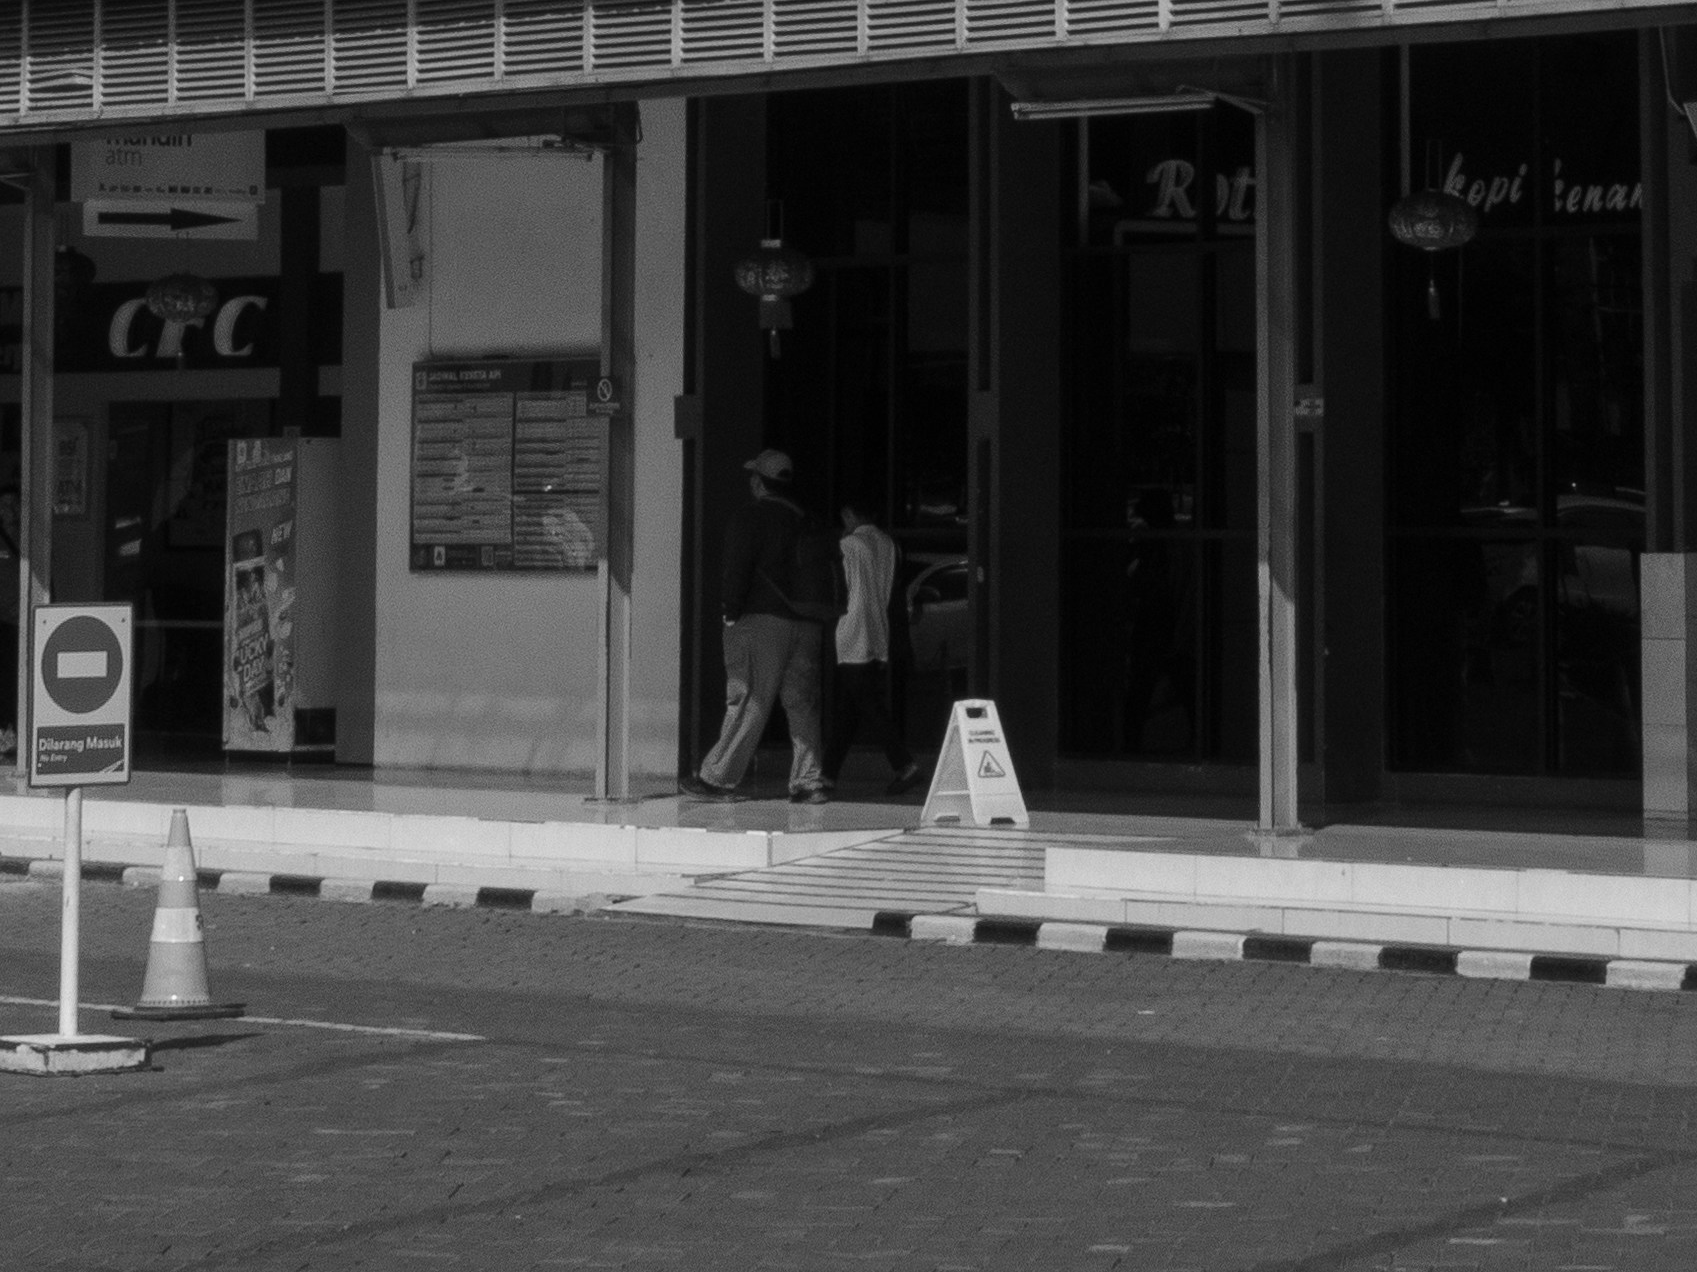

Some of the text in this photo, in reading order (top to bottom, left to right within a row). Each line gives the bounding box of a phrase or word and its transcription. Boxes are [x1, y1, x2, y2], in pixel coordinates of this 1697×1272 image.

[106, 149, 142, 166] atm
[1443, 152, 1528, 213] kopi
[270, 519, 293, 548] NEW
[39, 735, 121, 752] Dilarang Masuk
[50, 754, 67, 762] Entry
